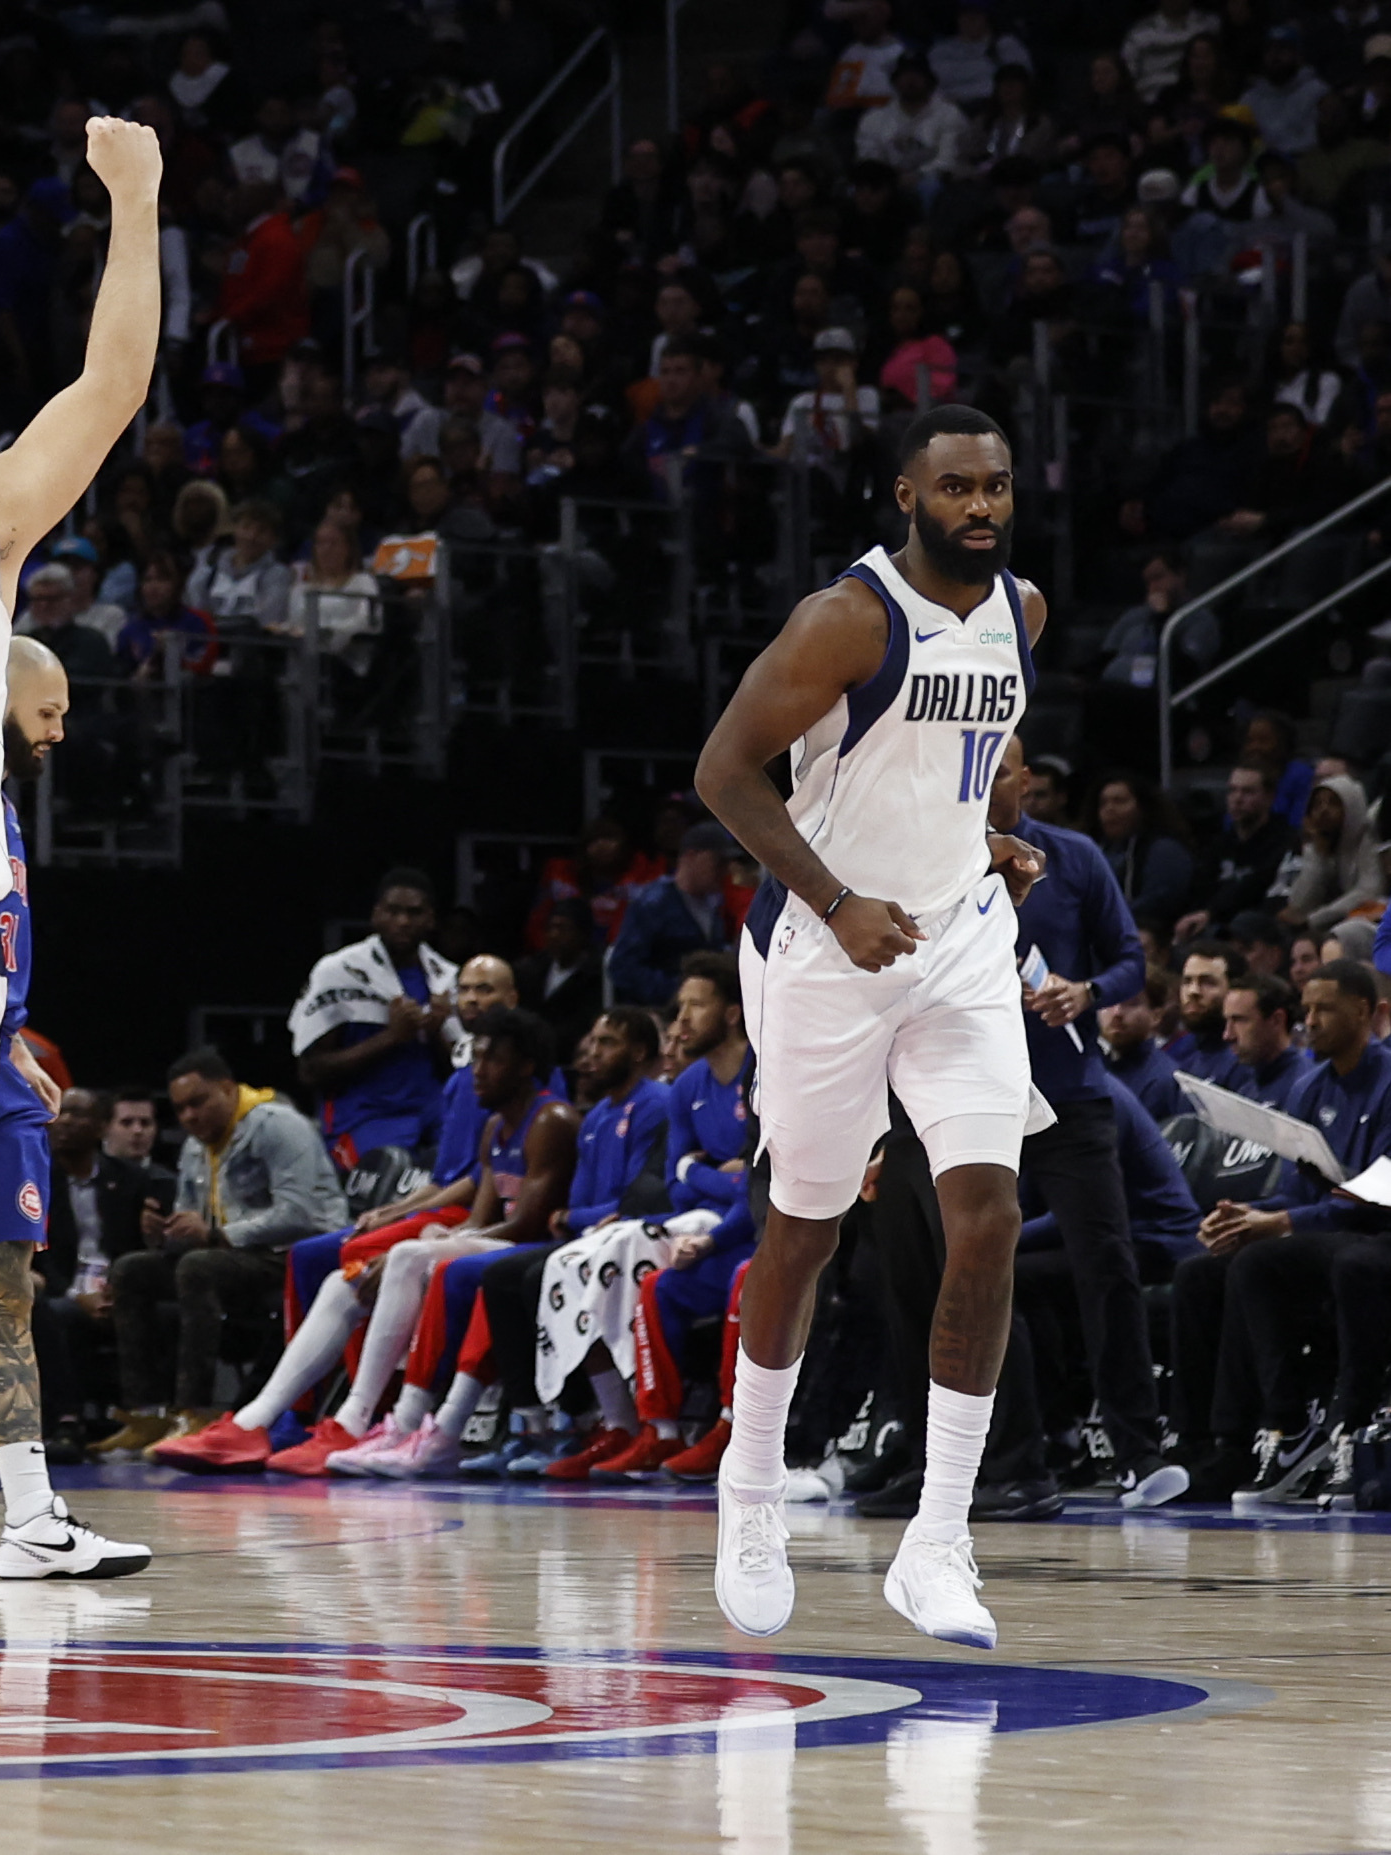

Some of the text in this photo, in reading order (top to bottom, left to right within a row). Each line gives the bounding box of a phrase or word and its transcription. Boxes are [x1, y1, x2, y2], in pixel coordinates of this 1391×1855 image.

[979, 628, 1013, 644] chime
[905, 674, 1017, 722] DALLAS
[957, 728, 1007, 804] 10
